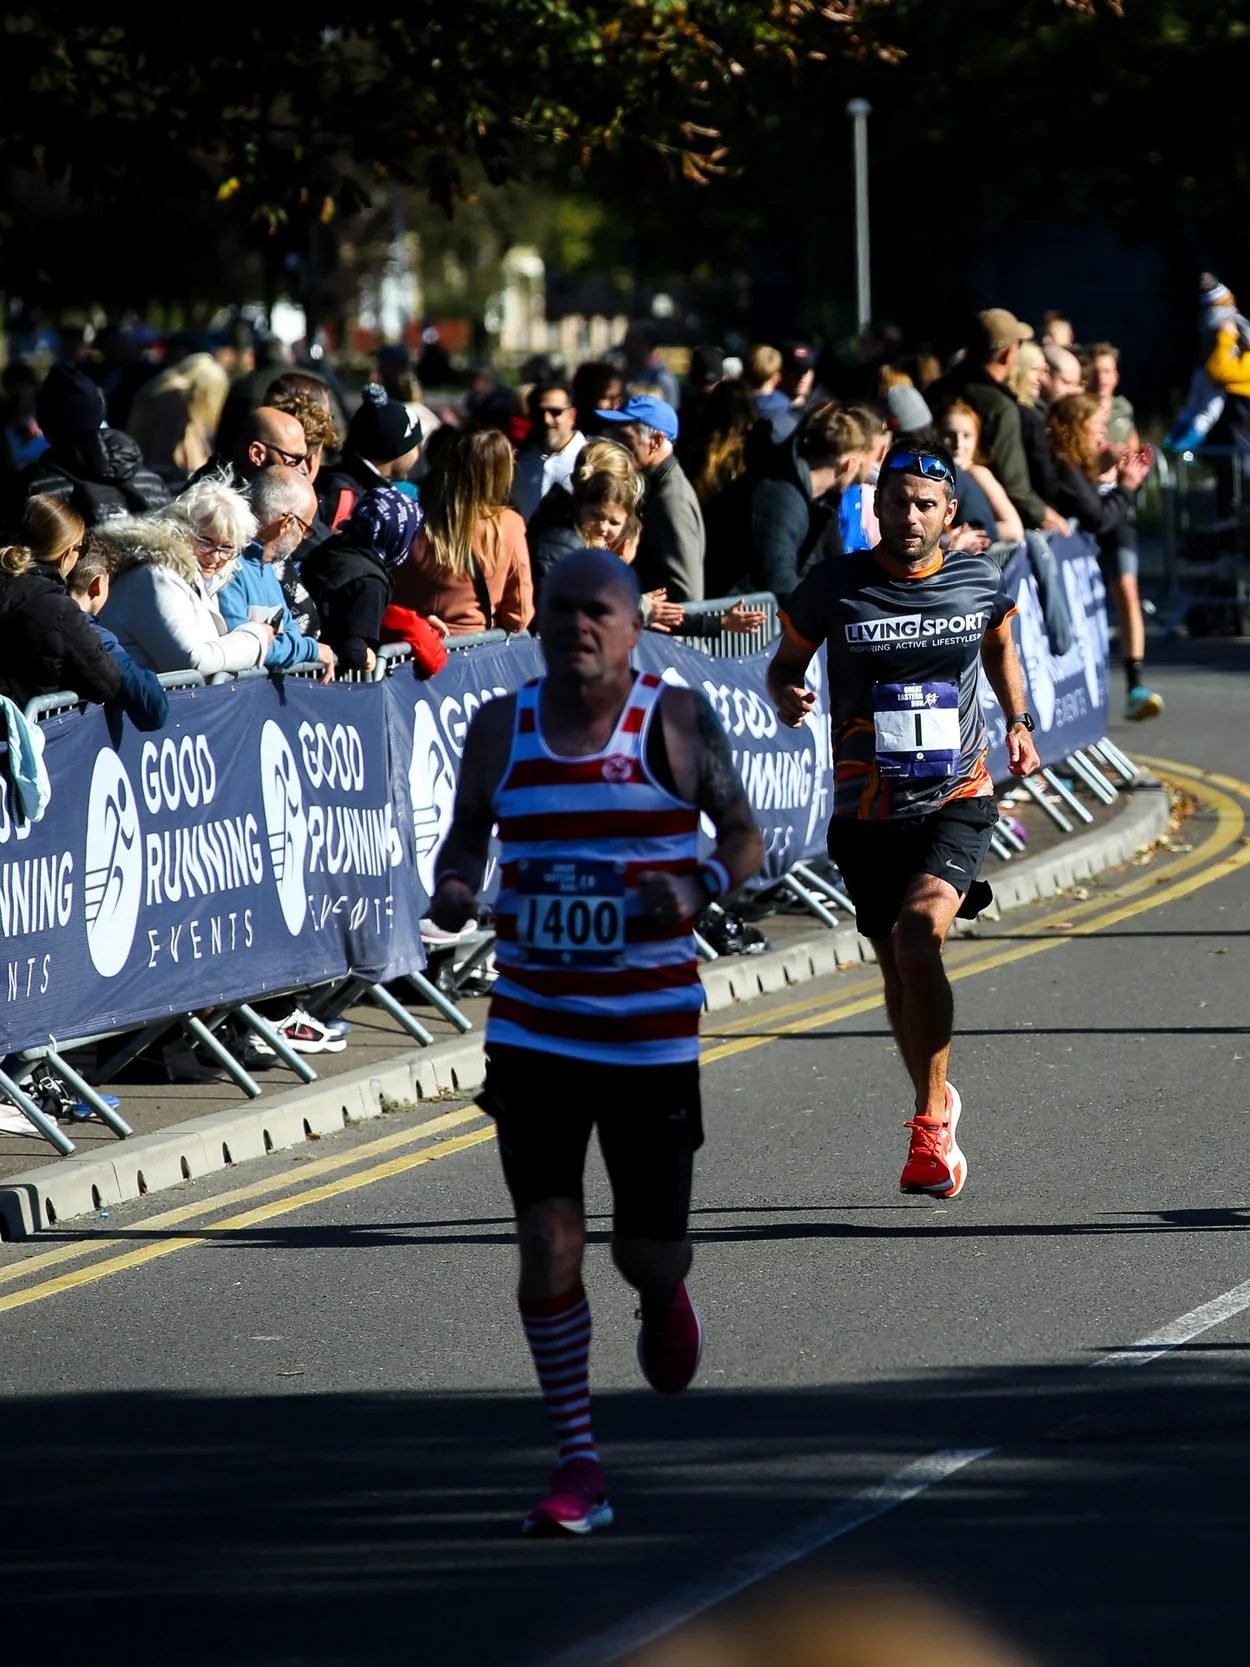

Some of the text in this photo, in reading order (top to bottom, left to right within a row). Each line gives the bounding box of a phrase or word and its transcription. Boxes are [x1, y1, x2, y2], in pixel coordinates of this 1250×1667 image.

[847, 611, 984, 640] LIVING SPORT
[850, 634, 977, 653] INSPIRING ACTIVE LIFESTYLES
[141, 734, 216, 814] GOOD
[298, 721, 364, 791] GOOD
[146, 813, 263, 905] RUNNING
[308, 802, 403, 876] RUNNING
[147, 910, 253, 968] EVENTS
[527, 899, 618, 945] 1400
